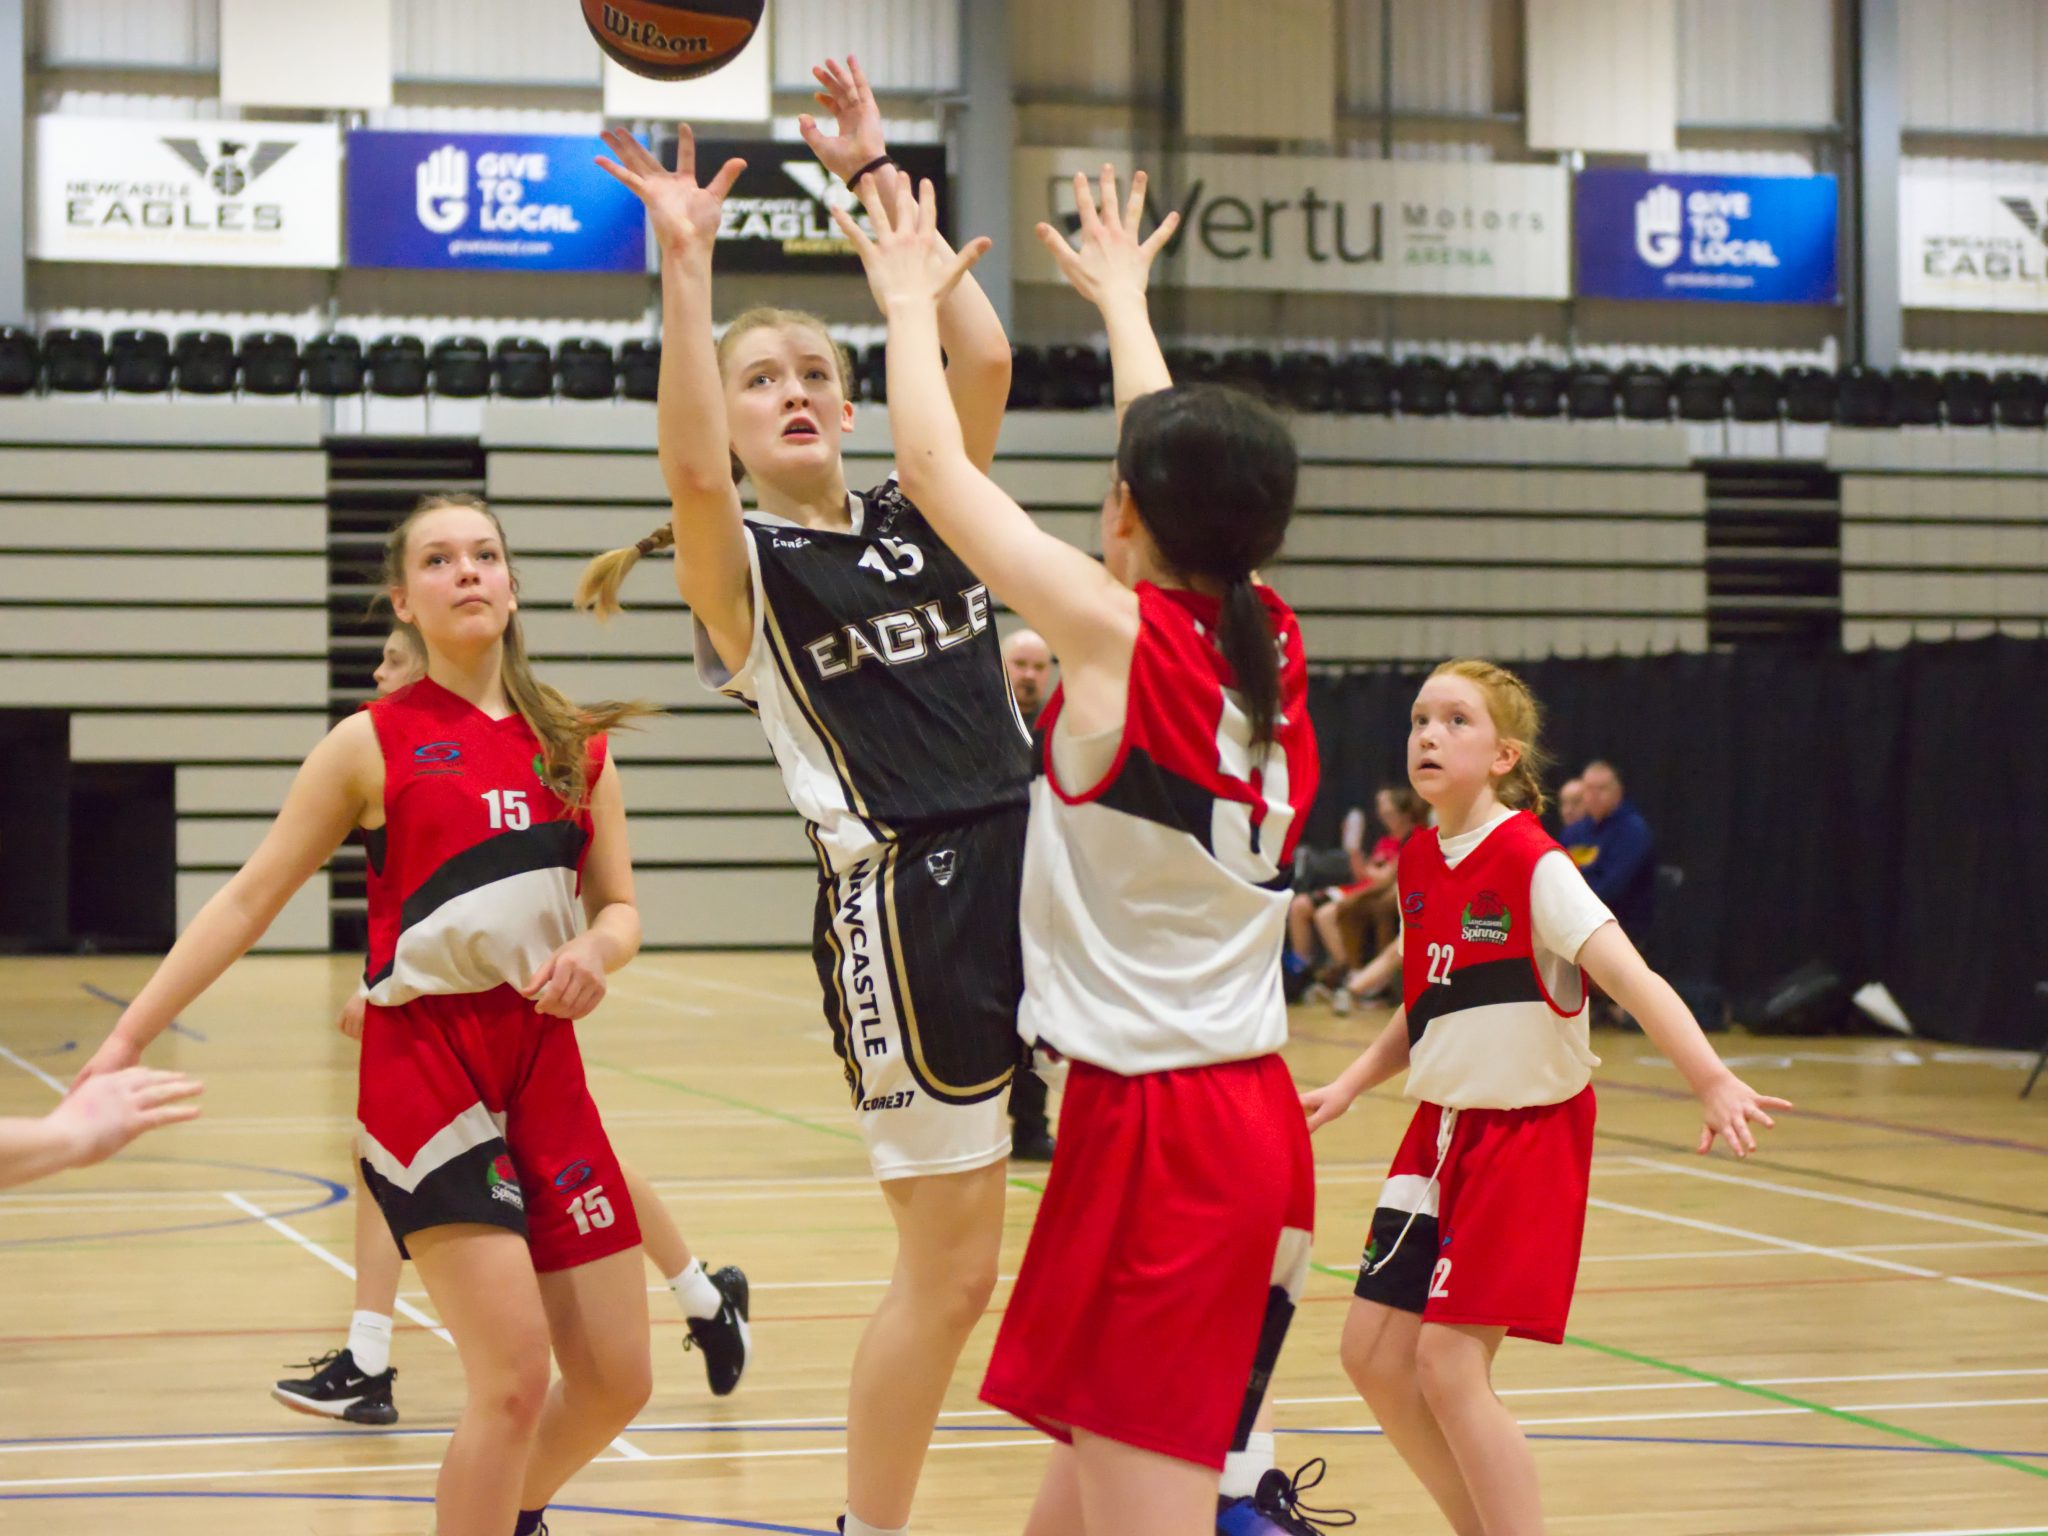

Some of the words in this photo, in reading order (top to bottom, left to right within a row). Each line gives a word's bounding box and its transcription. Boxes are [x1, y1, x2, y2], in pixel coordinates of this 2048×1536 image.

[603, 4, 708, 52] Wilson
[476, 152, 547, 181] GIVE
[477, 178, 523, 204] TO
[1687, 191, 1751, 219] GIVE
[66, 200, 282, 231] EAGLES
[480, 204, 581, 233] LOCAL
[1145, 179, 1382, 263] Vertu
[1689, 216, 1730, 241] TO
[1924, 252, 2048, 281] EAGL
[857, 536, 924, 583] 15
[803, 583, 988, 681] EAGLE
[480, 789, 531, 831] 15
[1461, 925, 1509, 943] Spinners
[1427, 942, 1455, 986] 22
[862, 1090, 916, 1112] CORE37
[566, 1184, 616, 1236] 15
[1428, 1257, 1452, 1299] 2
